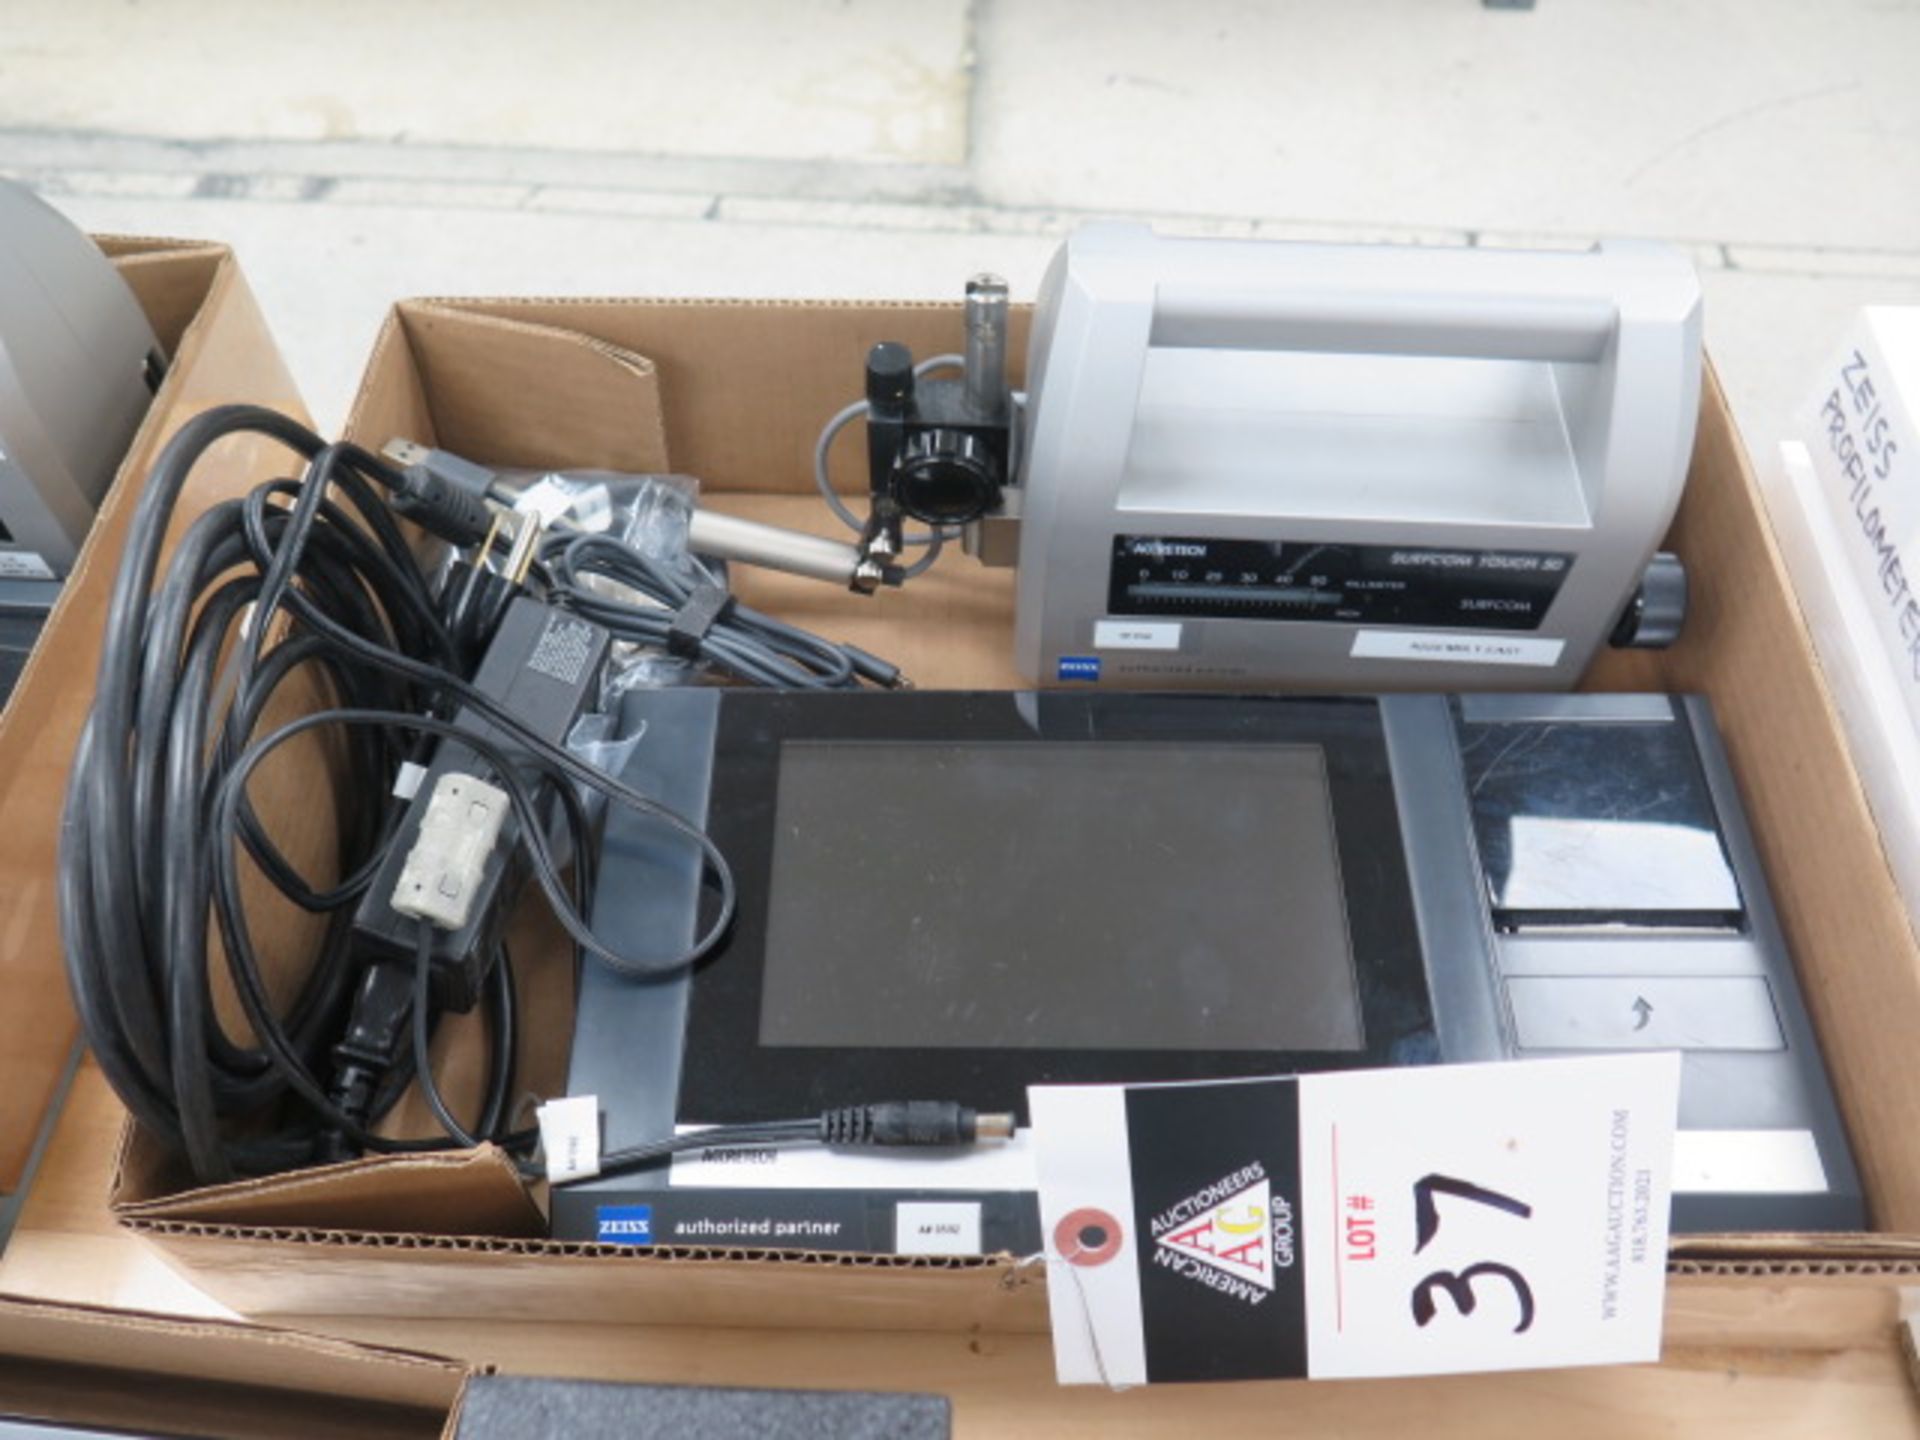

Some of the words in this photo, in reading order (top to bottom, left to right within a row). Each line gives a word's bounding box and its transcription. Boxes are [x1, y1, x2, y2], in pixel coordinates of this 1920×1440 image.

[1842, 350, 1898, 481] ZEISS
[1171, 569, 1189, 581] 10
[599, 1219, 650, 1235] ZEISS
[674, 1217, 771, 1236] authorized
[774, 1220, 842, 1238] partner
[1150, 1160, 1266, 1238] AUCTIONEERS
[1271, 1195, 1295, 1268] GROUP
[1346, 1216, 1376, 1261] LOT
[1411, 1172, 1535, 1335] 37
[1153, 1246, 1267, 1305] AMERICAN
